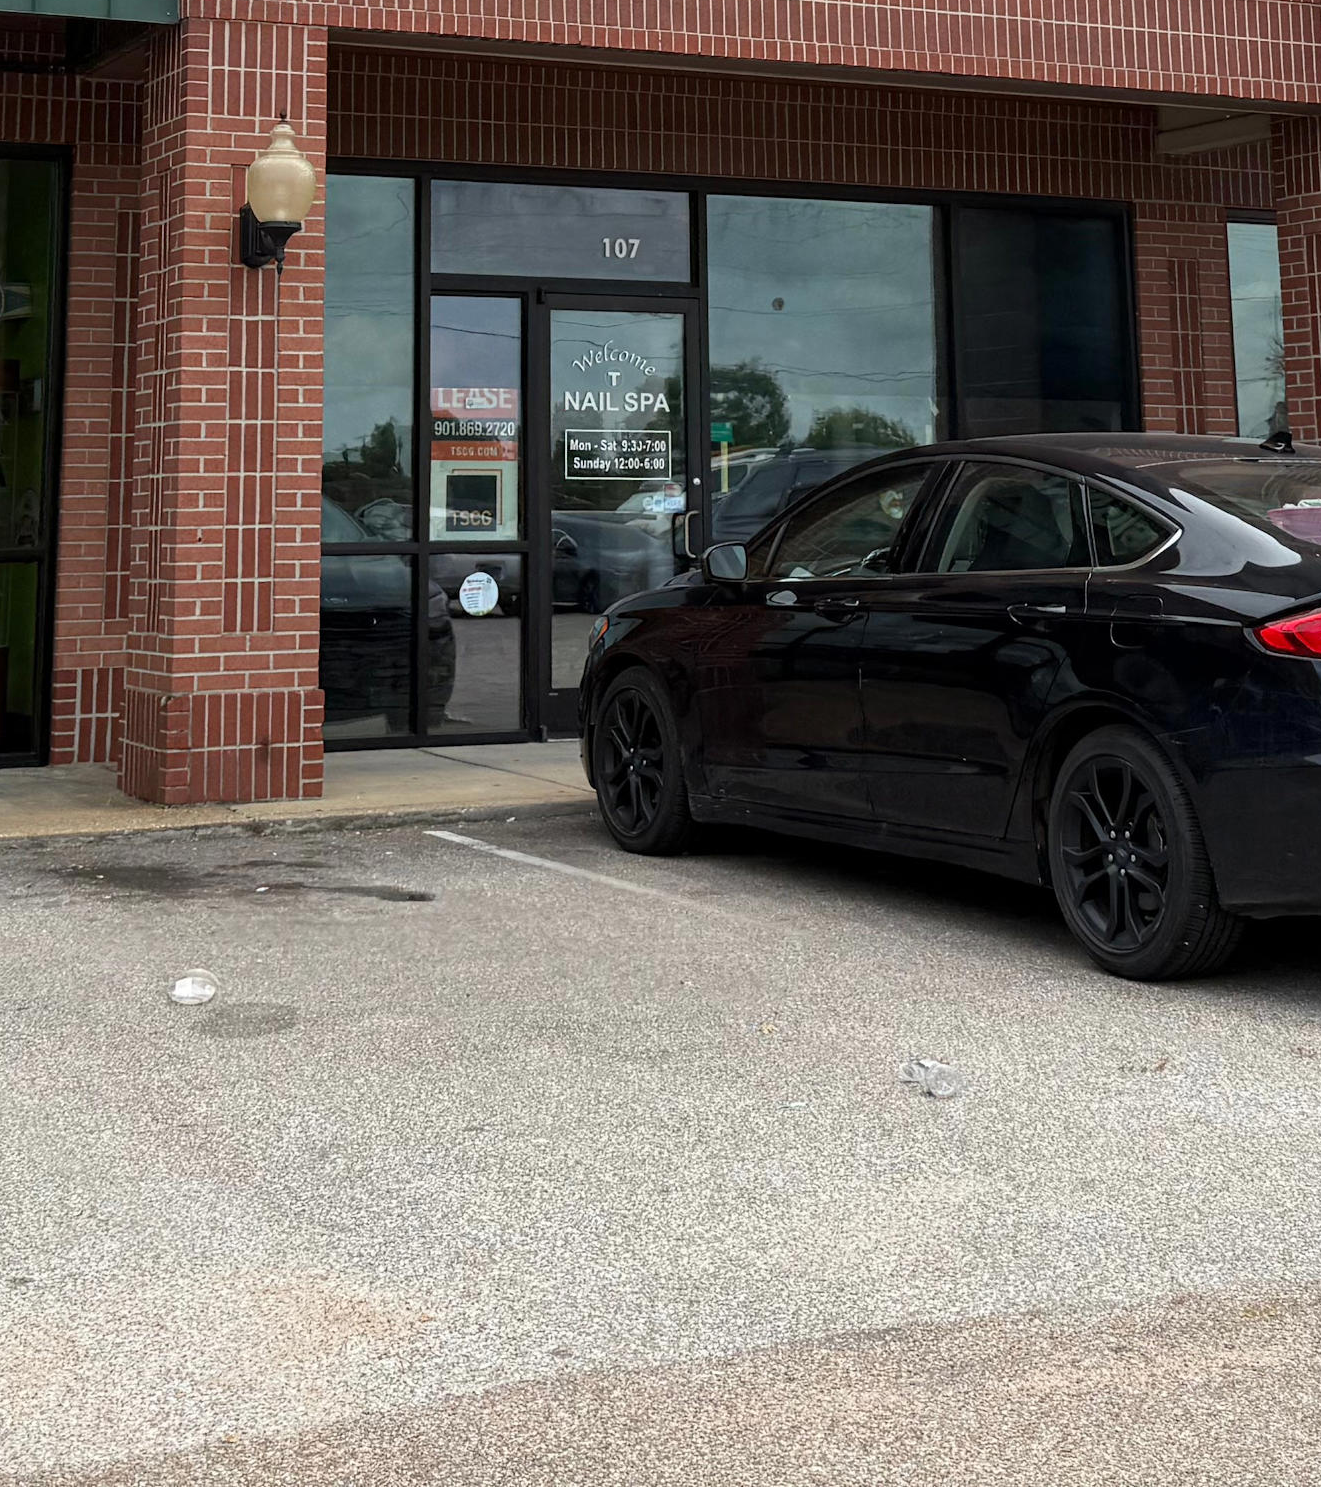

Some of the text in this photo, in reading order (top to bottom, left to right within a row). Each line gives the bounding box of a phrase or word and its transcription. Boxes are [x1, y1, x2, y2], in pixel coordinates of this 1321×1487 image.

[602, 238, 641, 258] 107
[572, 339, 656, 377] Welcome
[608, 371, 621, 387] T
[437, 388, 512, 409] LEASE
[564, 391, 670, 412] NAIL SPA
[434, 421, 516, 436] 901.869.2720
[450, 446, 498, 456] TSCG.COM
[569, 439, 592, 451] Mon
[600, 439, 618, 451] Sat
[621, 440, 667, 452] 9:30-7:00
[573, 457, 665, 472] Sunday 12:00-6:00
[452, 509, 493, 526] TSCG
